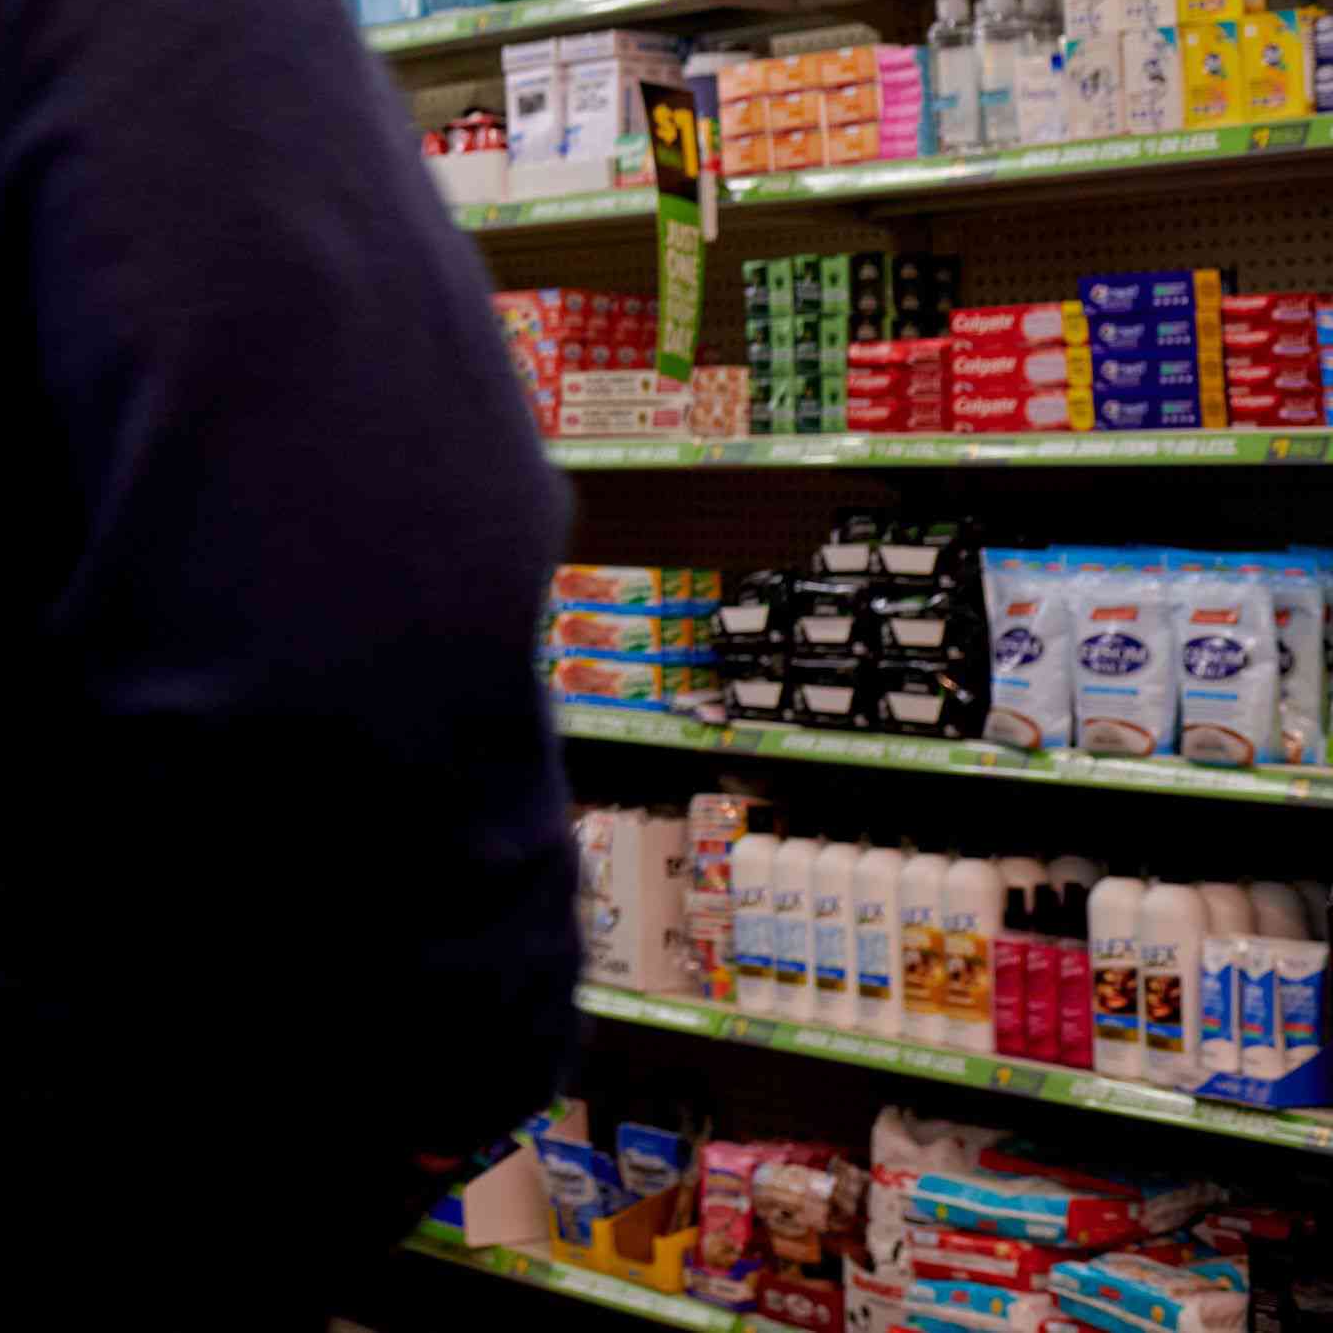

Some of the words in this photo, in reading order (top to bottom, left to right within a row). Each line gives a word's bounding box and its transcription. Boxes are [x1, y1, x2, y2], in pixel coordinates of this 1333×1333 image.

[951, 311, 1016, 338] Colgate
[952, 354, 1017, 378] Colgate
[953, 394, 1018, 419] Colgate
